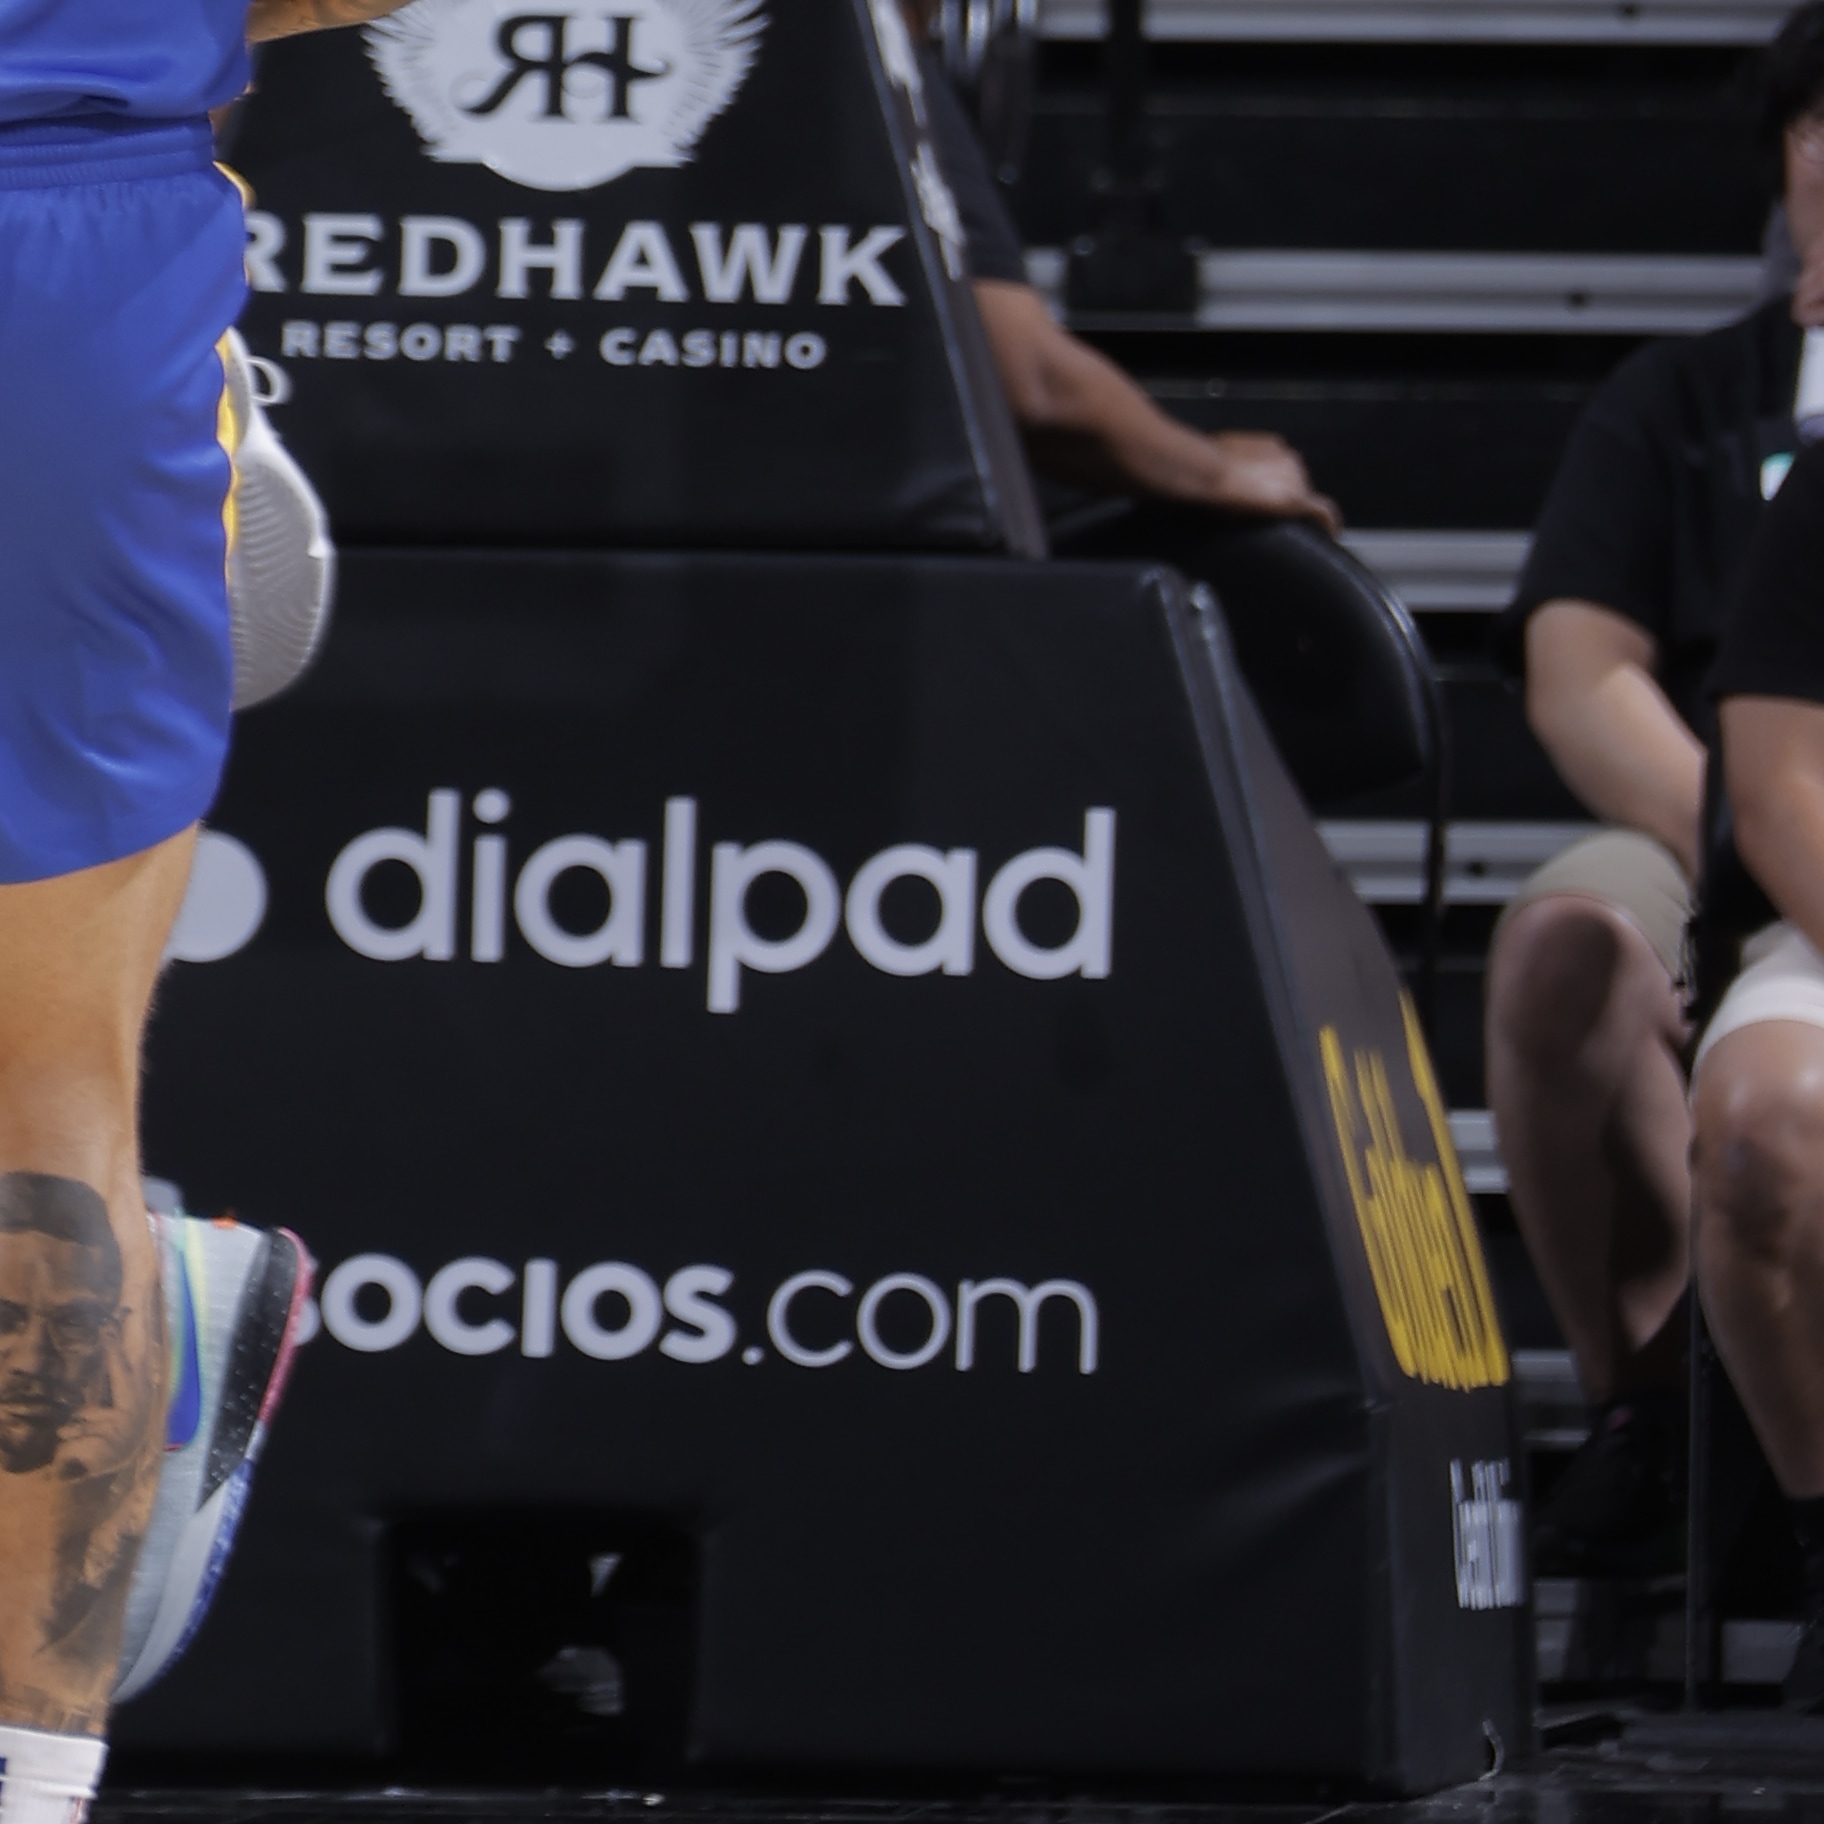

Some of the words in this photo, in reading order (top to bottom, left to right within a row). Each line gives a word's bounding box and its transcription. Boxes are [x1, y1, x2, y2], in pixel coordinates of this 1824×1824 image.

[281, 319, 522, 364] RESORT
[599, 327, 828, 370] CASINO
[325, 788, 1117, 1014] dialpad
